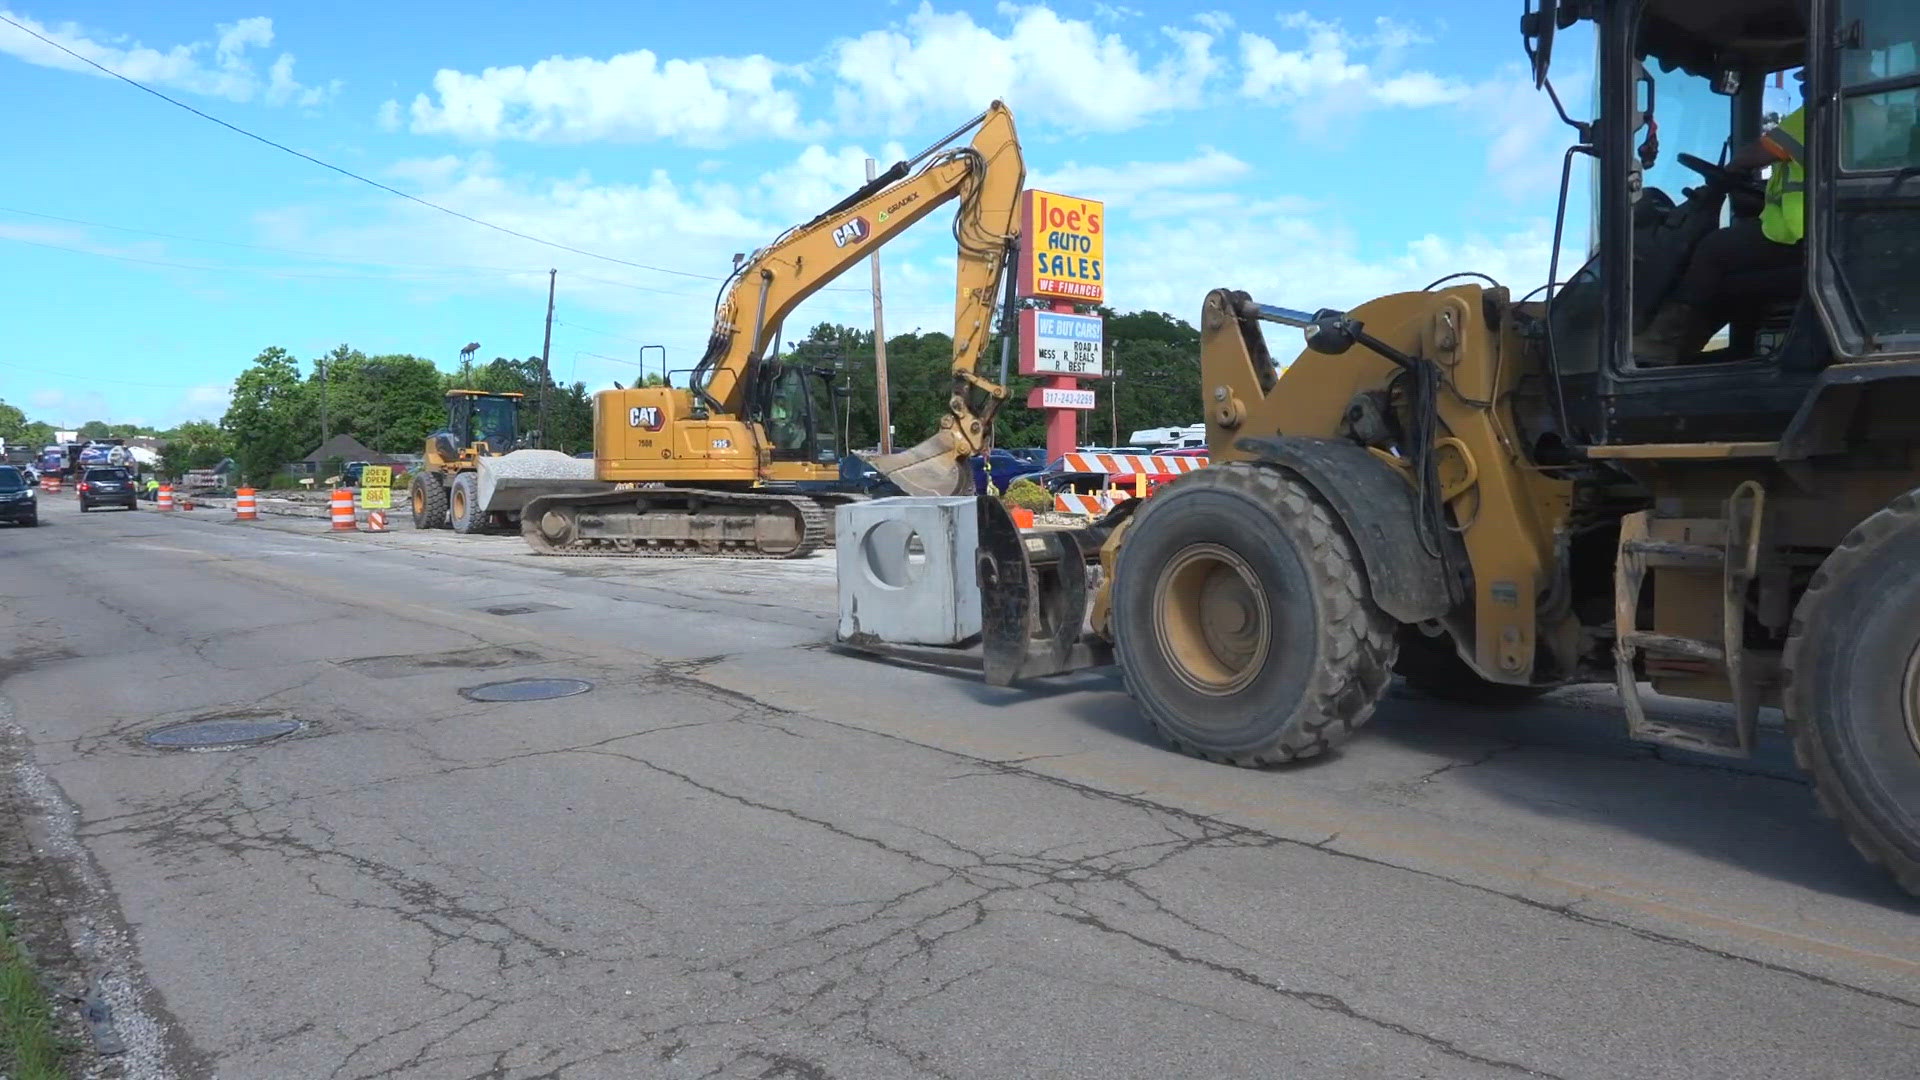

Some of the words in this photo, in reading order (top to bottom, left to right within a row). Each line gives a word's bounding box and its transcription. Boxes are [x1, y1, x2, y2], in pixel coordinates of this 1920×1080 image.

[887, 191, 919, 214] GRADEX
[1039, 197, 1100, 234] Joe's
[832, 218, 862, 248] CAT
[1048, 231, 1091, 254] AUTO
[1038, 252, 1101, 280] SALES
[1040, 279, 1054, 291] WE
[1058, 281, 1100, 297] FINANCE!
[1040, 318, 1054, 335] WE
[1056, 320, 1075, 337] BUY
[1075, 322, 1100, 338] CARS!
[1039, 349, 1056, 359] MESS
[1074, 352, 1095, 363] DEALS
[1074, 341, 1091, 352] ROAD
[1094, 343, 1098, 352] A
[1068, 361, 1086, 372] BEST
[629, 407, 657, 427] CAT
